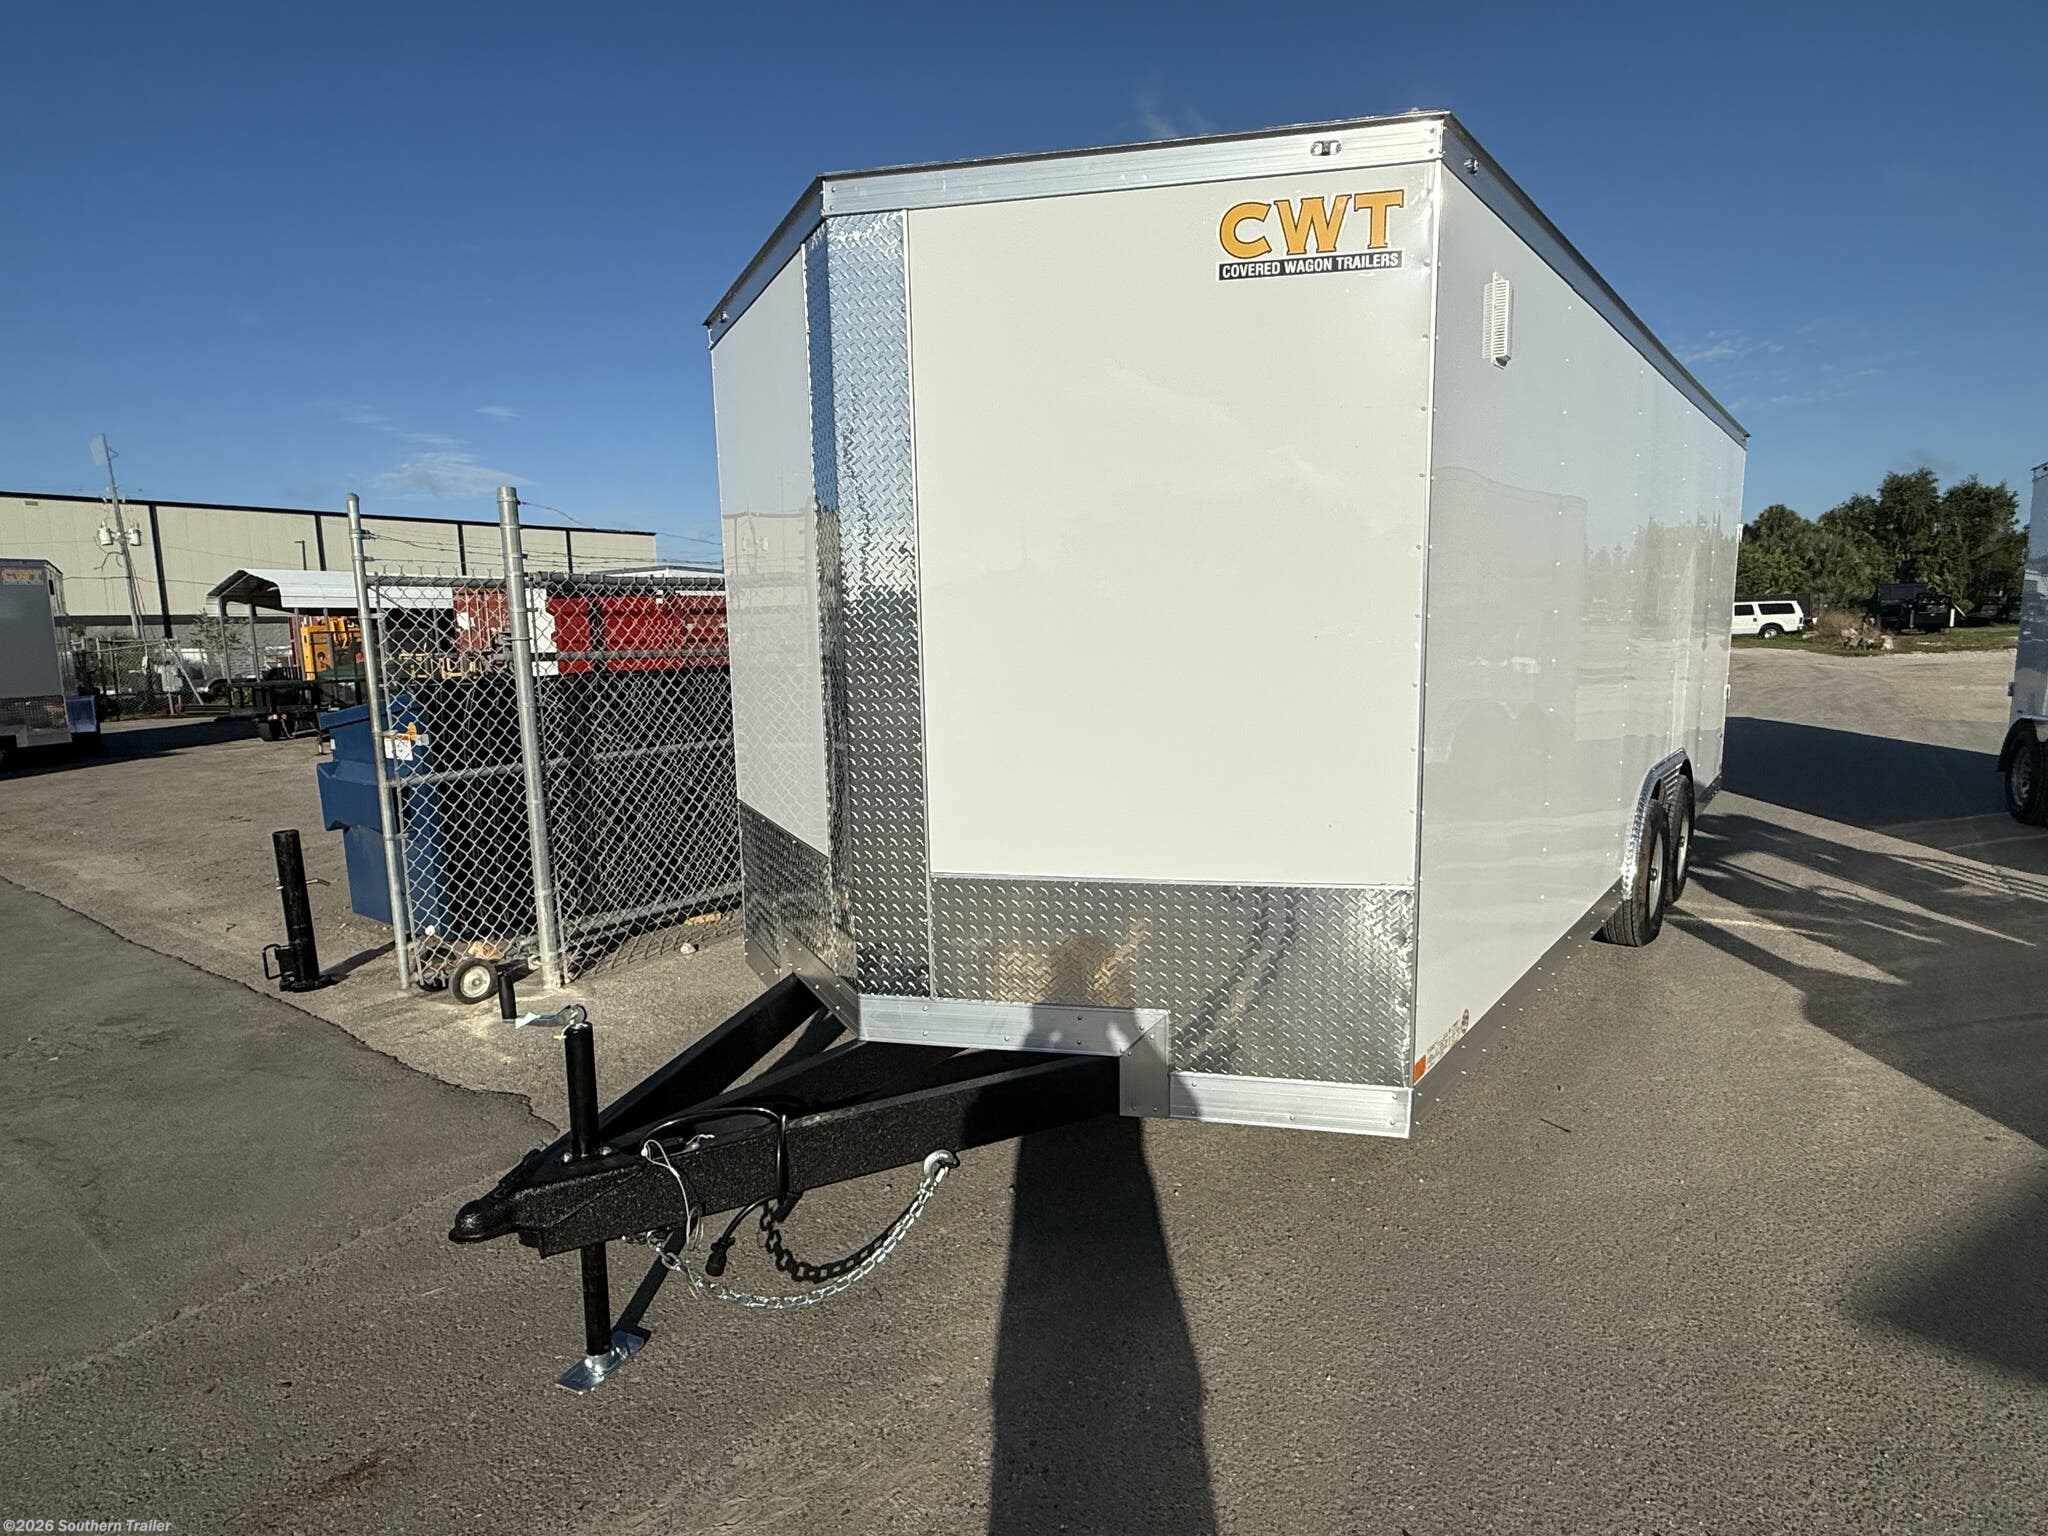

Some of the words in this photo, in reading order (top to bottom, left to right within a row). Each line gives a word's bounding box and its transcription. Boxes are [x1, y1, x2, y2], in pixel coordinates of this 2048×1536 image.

[1220, 190, 1404, 259] CWT
[1222, 262, 1280, 278] COVERED
[1284, 259, 1332, 274] WAGON
[1336, 253, 1399, 269] TRAILERS
